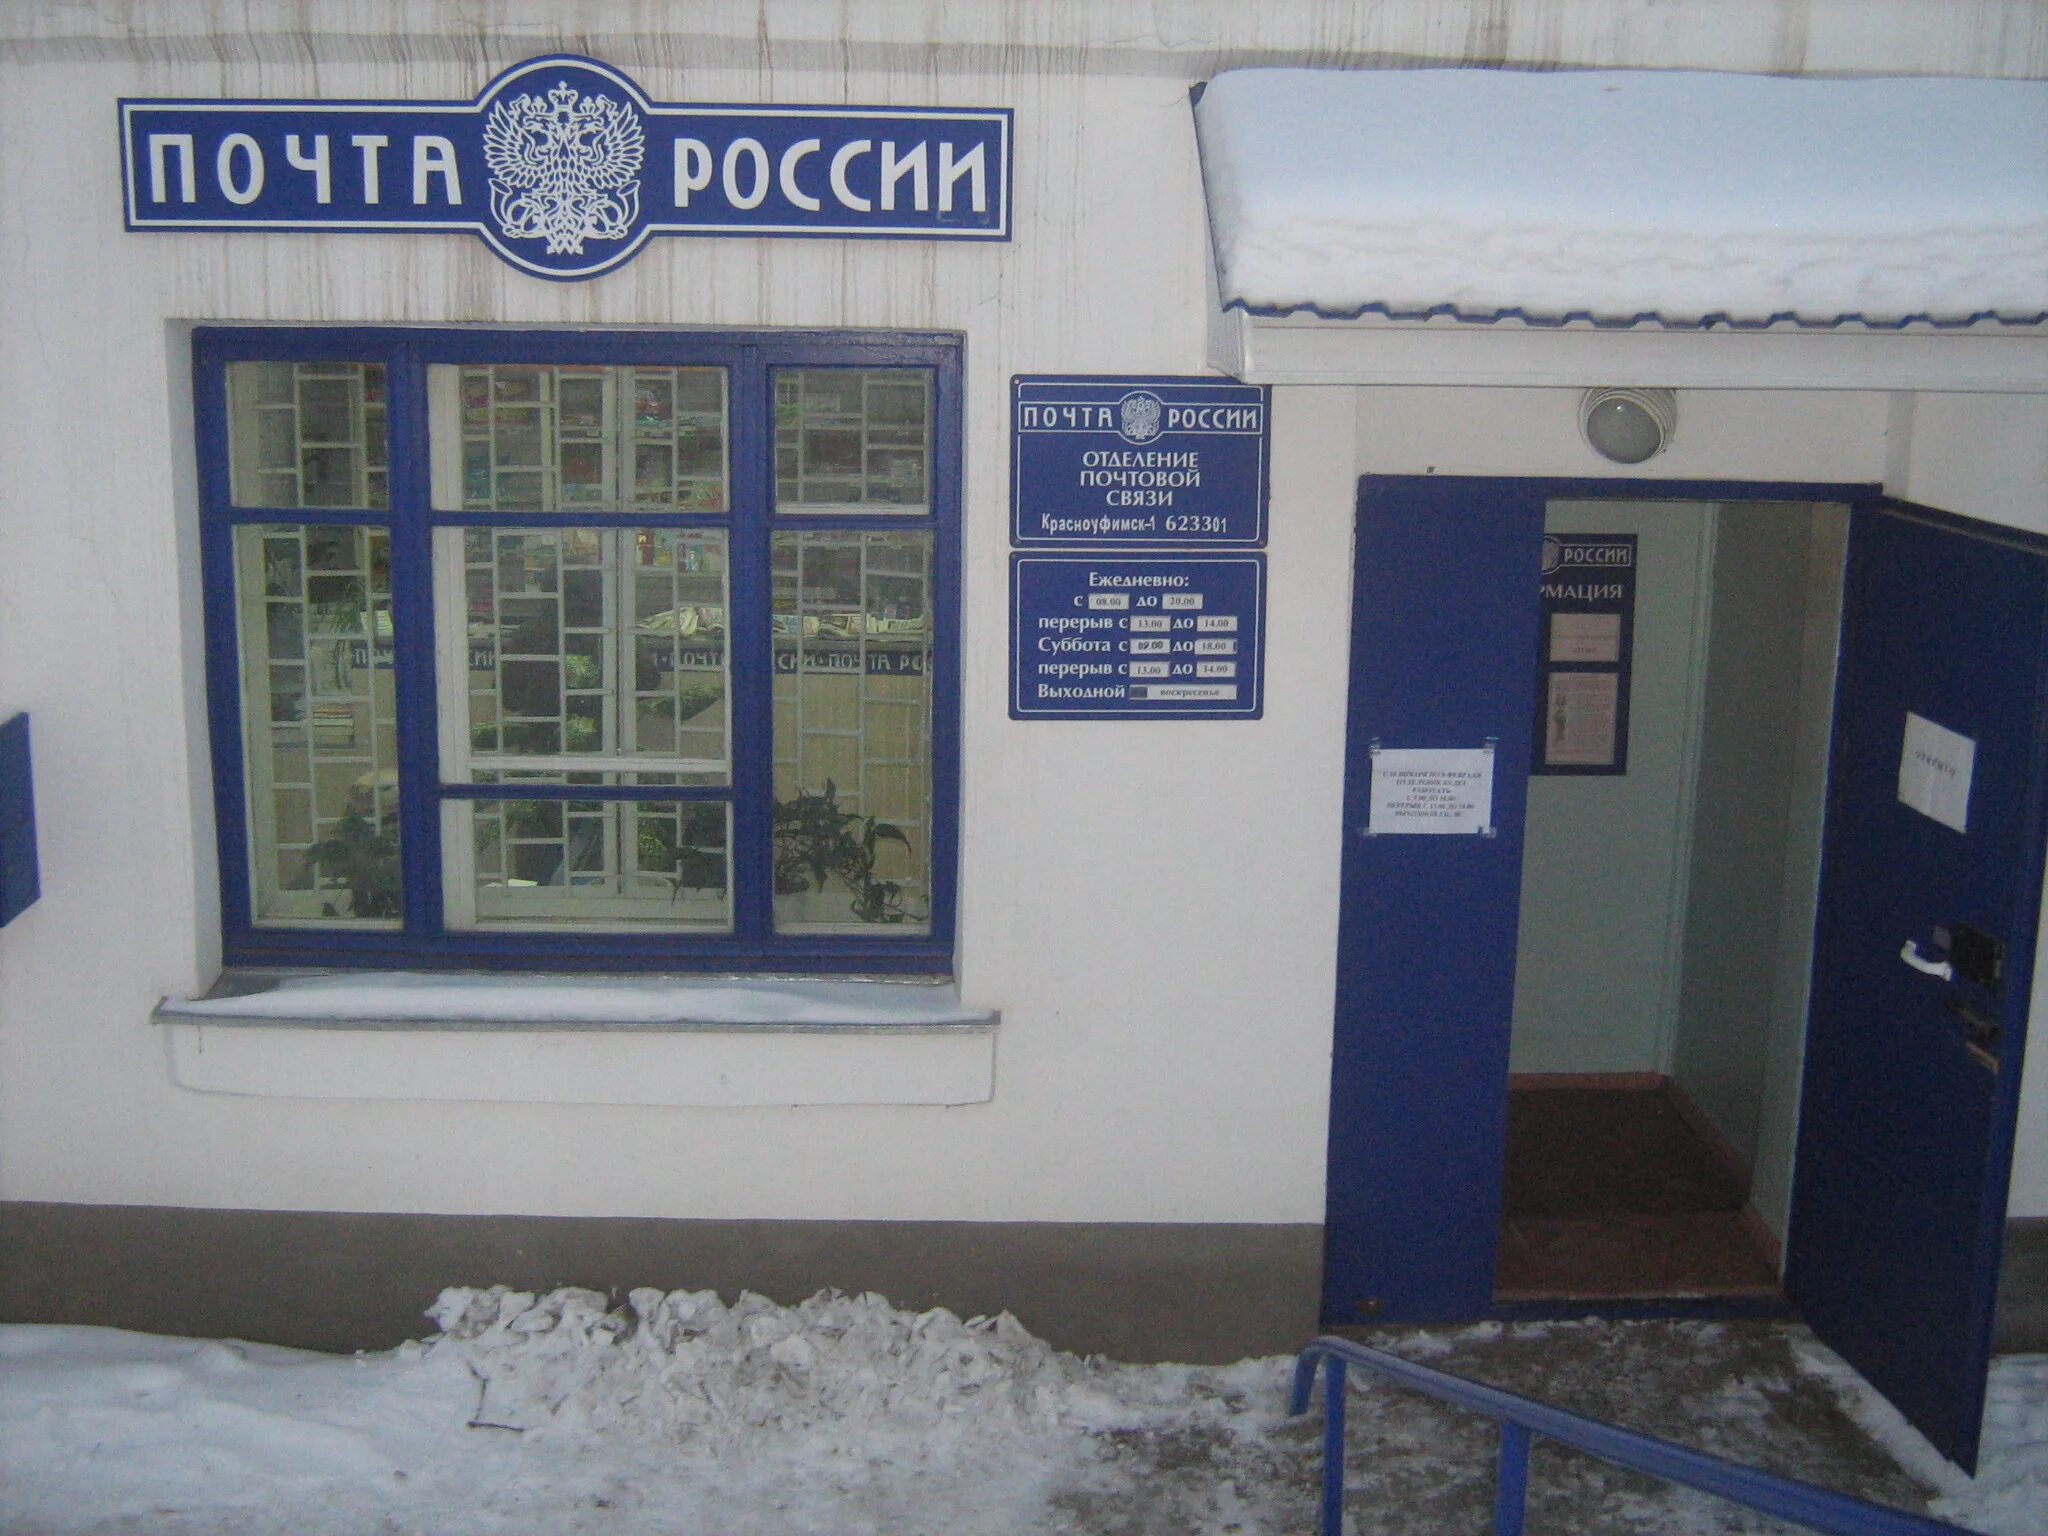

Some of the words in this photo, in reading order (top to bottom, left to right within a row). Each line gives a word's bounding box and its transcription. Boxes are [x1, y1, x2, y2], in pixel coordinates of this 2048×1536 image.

[151, 133, 462, 205] ПОЧТА
[674, 137, 987, 212] РОССИИ
[1023, 406, 1113, 428] ПОЧТА
[1168, 408, 1257, 429] РОССИИ
[1082, 451, 1199, 468] ОТДЕЛЕНИЕ
[1080, 469, 1200, 487] ПОЧТОВОЙ
[1106, 490, 1173, 506] СВЯЗИ
[1041, 512, 1156, 535] Красноуфимск-1
[1165, 515, 1227, 533] 623301
[1564, 548, 1626, 563] РОССИИ
[1089, 572, 1189, 587] Ежедневно:
[1096, 597, 1121, 606] 08.00
[1136, 595, 1157, 607] до
[1169, 596, 1195, 606] 20.00
[1038, 617, 1113, 633] перерыв
[1138, 619, 1163, 629] 13.00
[1172, 617, 1194, 629] до
[1204, 619, 1229, 628] 14.00
[1038, 637, 1111, 655] Суббота
[1138, 641, 1163, 650] 09.00
[1172, 640, 1194, 652] до
[1202, 641, 1226, 651] 18.00
[1038, 663, 1113, 679] перерыв
[1137, 665, 1161, 675] 13.00
[1172, 663, 1193, 675] до
[1203, 664, 1228, 674] 14.00
[1038, 683, 1125, 698] Выходной
[1160, 688, 1220, 699] воскресенье
